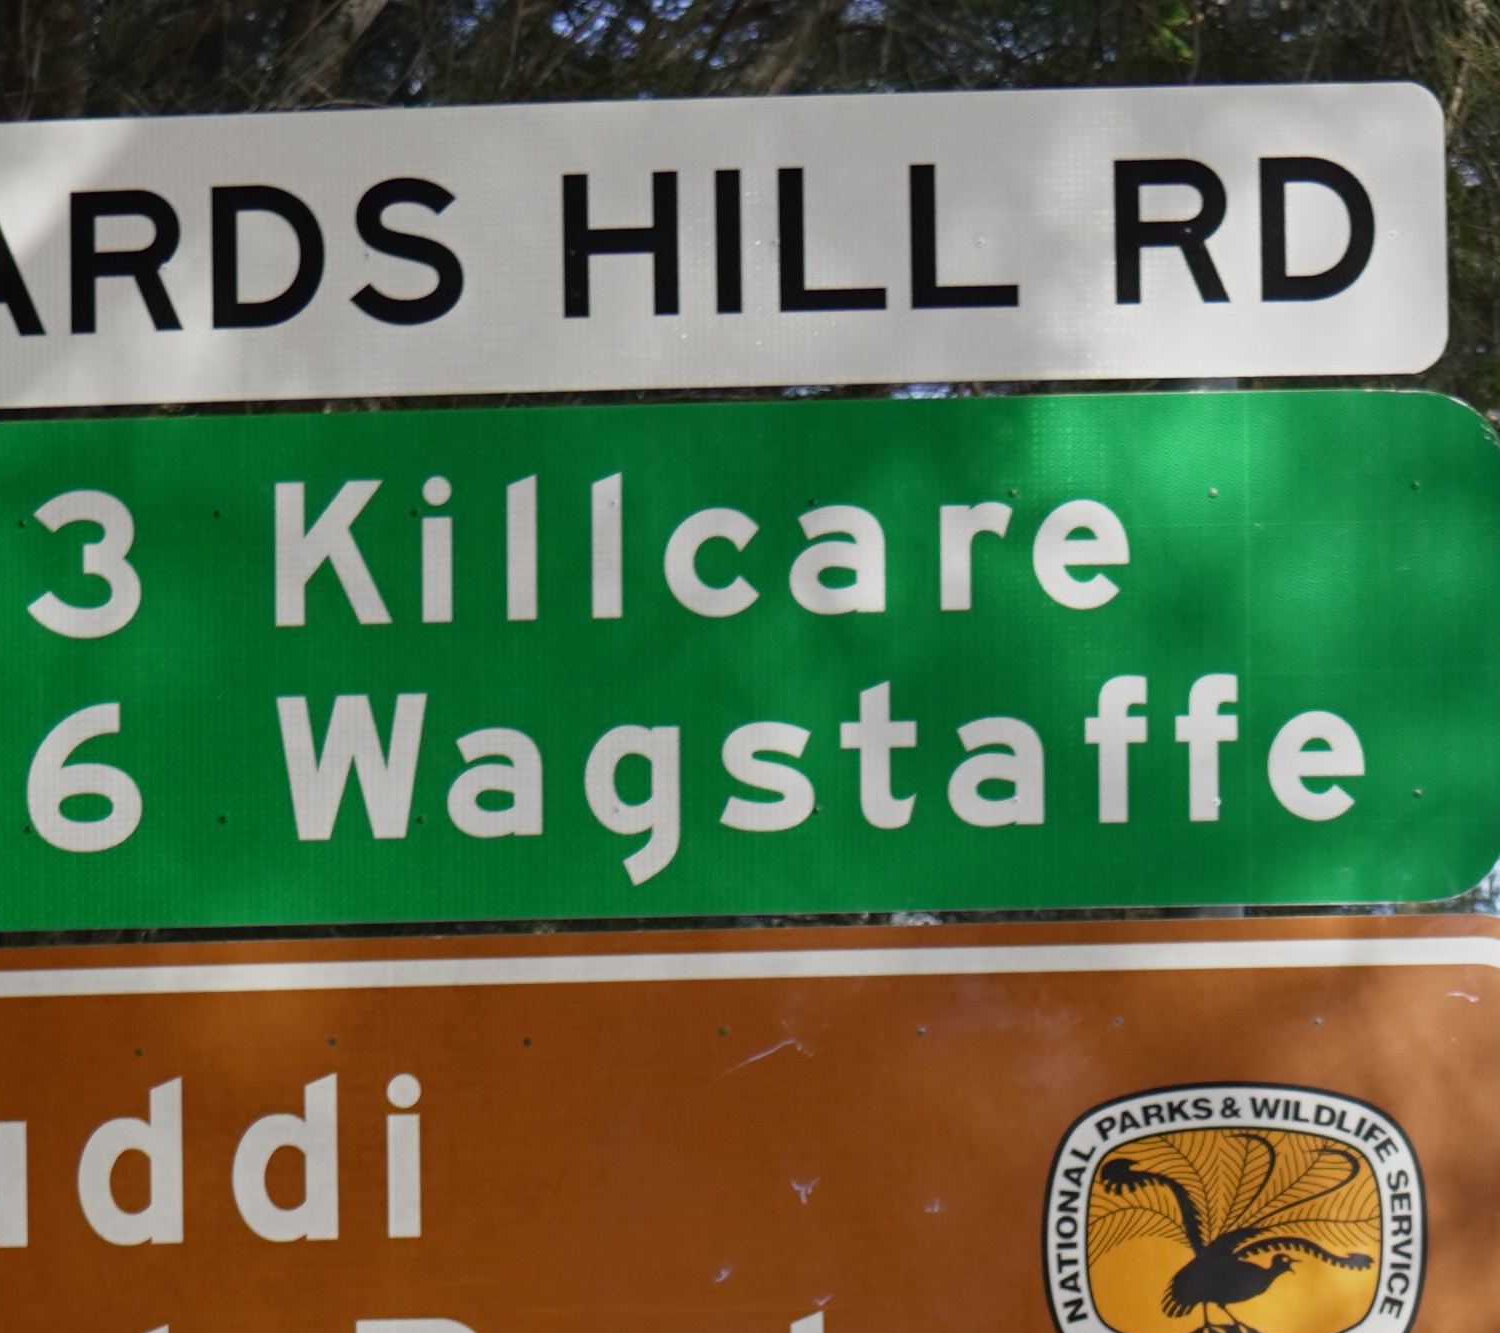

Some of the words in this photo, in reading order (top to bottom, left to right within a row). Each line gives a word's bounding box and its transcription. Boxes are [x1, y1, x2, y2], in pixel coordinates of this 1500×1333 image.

[561, 163, 1019, 318] HILL
[1112, 156, 1376, 304] RD
[26, 489, 143, 640] 3
[273, 472, 1132, 628] Killcare
[25, 701, 144, 854] 6
[275, 673, 1367, 886] Wagstaffe
[1055, 1143, 1098, 1323] NATIONAL
[1094, 1097, 1213, 1142] PARKS
[1219, 1097, 1241, 1120] &
[1248, 1097, 1400, 1164] WILDLIFE
[1378, 1168, 1413, 1320] SERVICE
